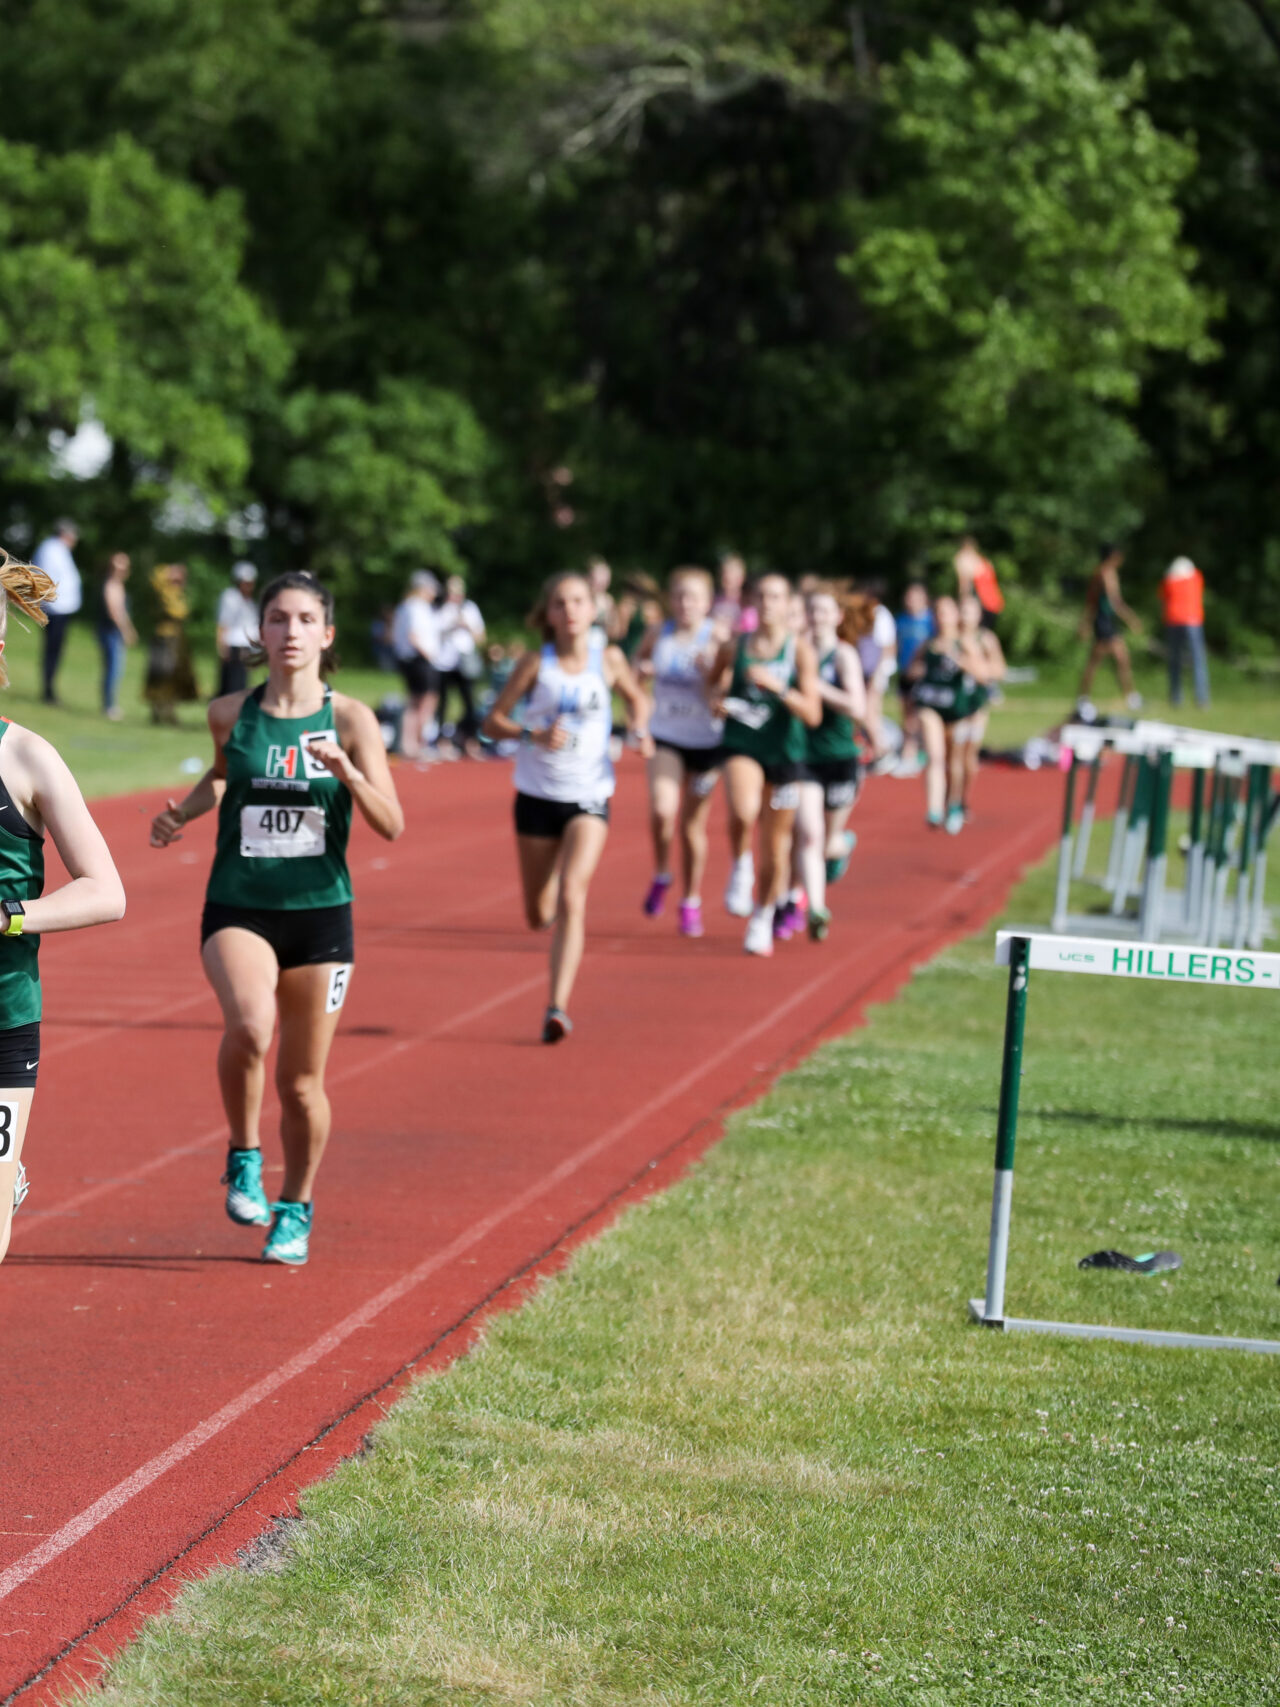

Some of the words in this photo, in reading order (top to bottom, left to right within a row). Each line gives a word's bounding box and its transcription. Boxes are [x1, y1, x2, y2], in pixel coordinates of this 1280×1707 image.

[265, 744, 299, 779] H
[259, 809, 305, 834] 407
[331, 969, 345, 1006] 5
